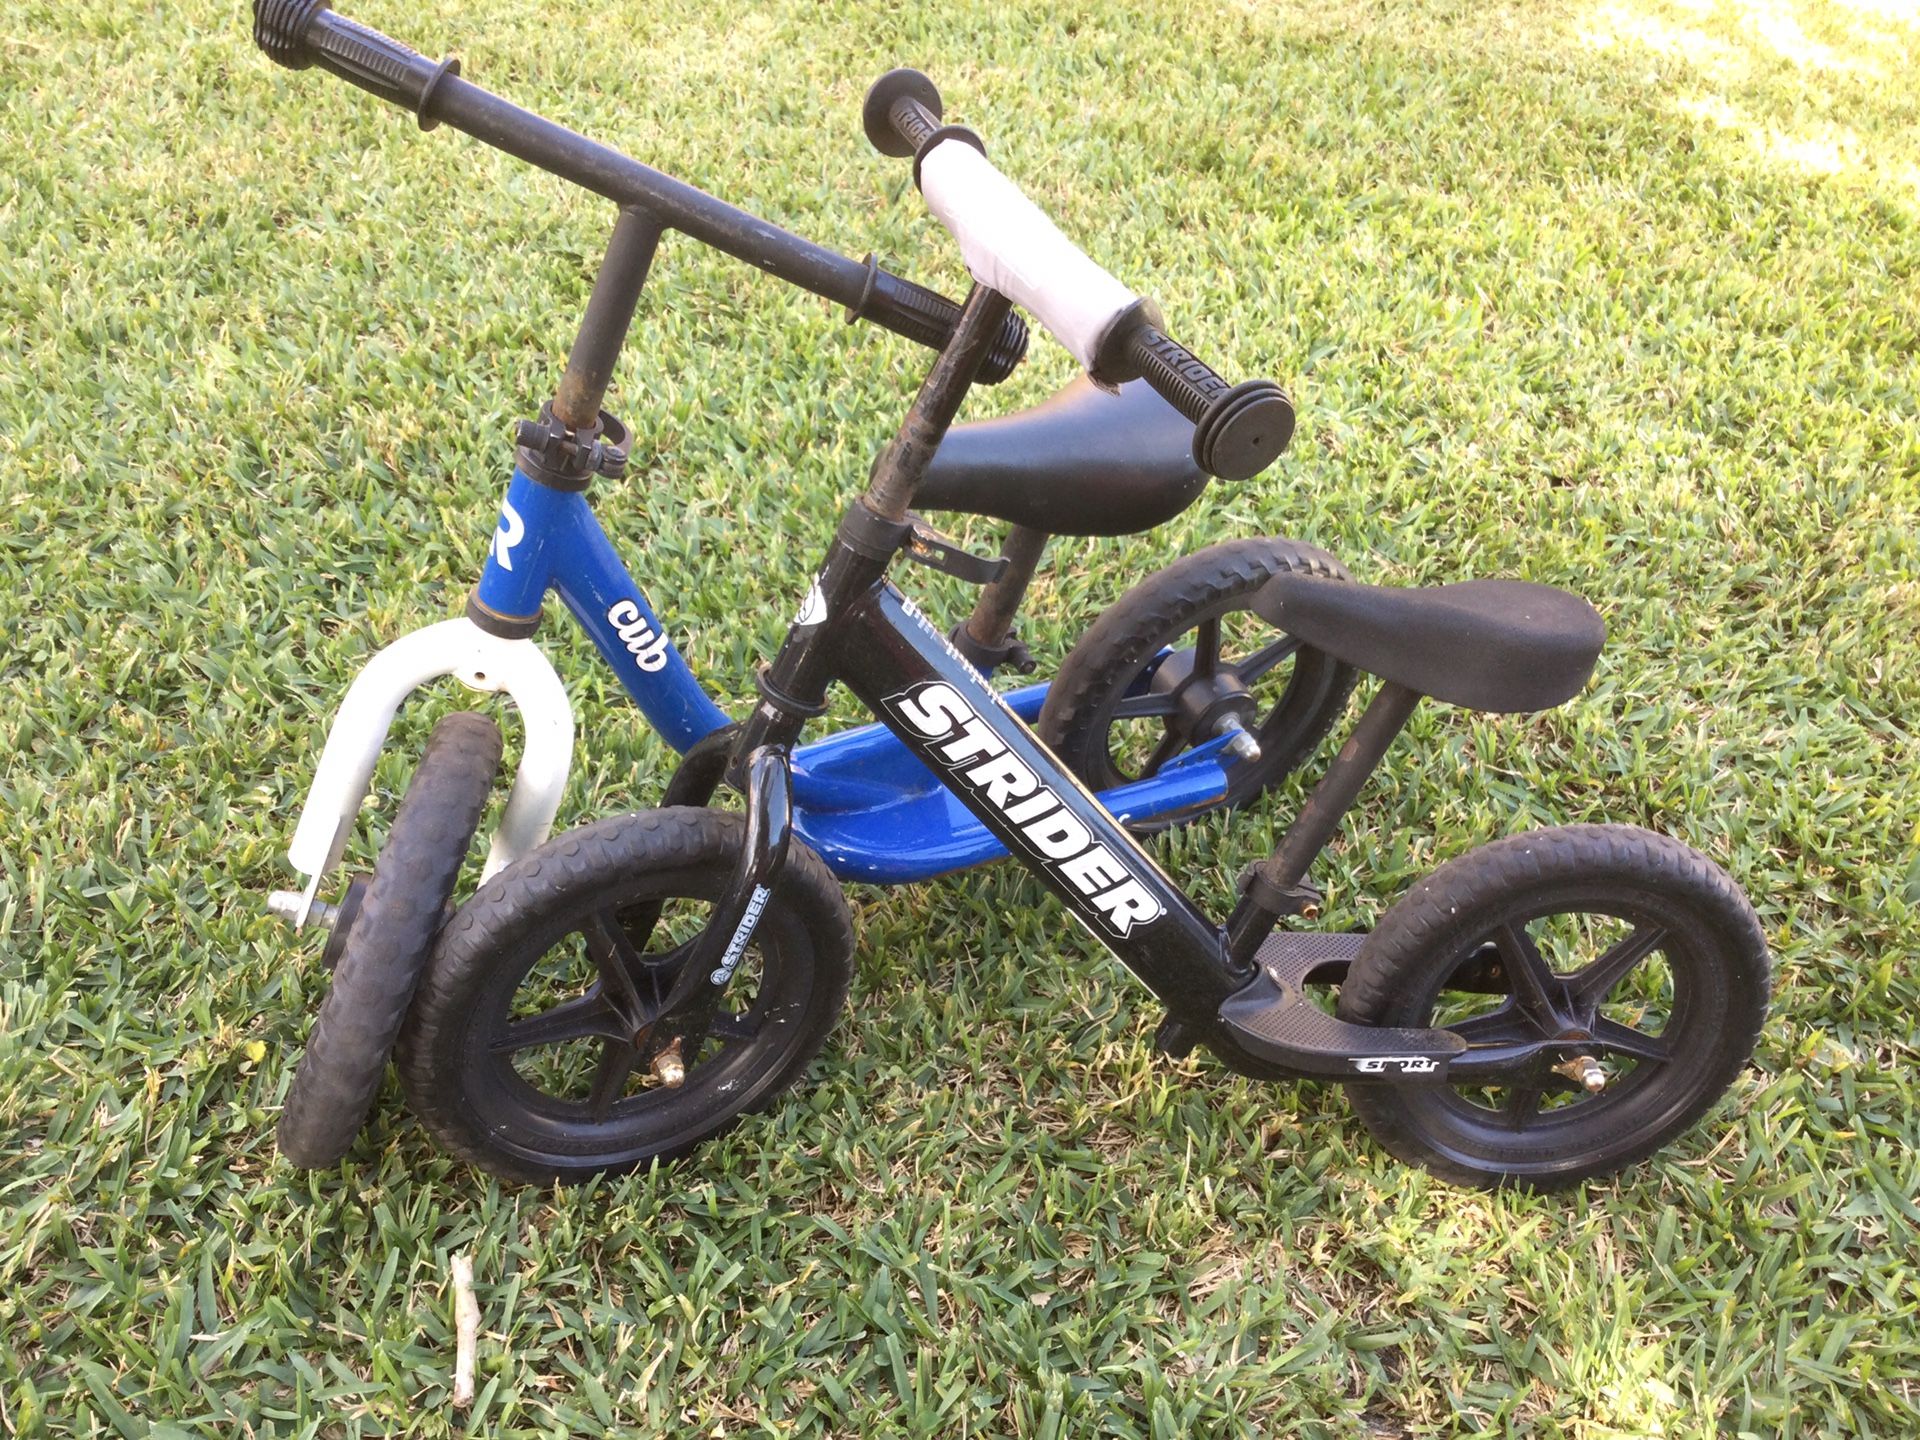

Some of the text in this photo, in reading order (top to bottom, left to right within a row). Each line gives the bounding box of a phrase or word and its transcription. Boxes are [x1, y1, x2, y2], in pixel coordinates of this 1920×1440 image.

[607, 599, 670, 673] cub
[896, 683, 1162, 936] STRIDER
[721, 884, 771, 970] STRIDER
[1364, 1058, 1440, 1072] SORT
